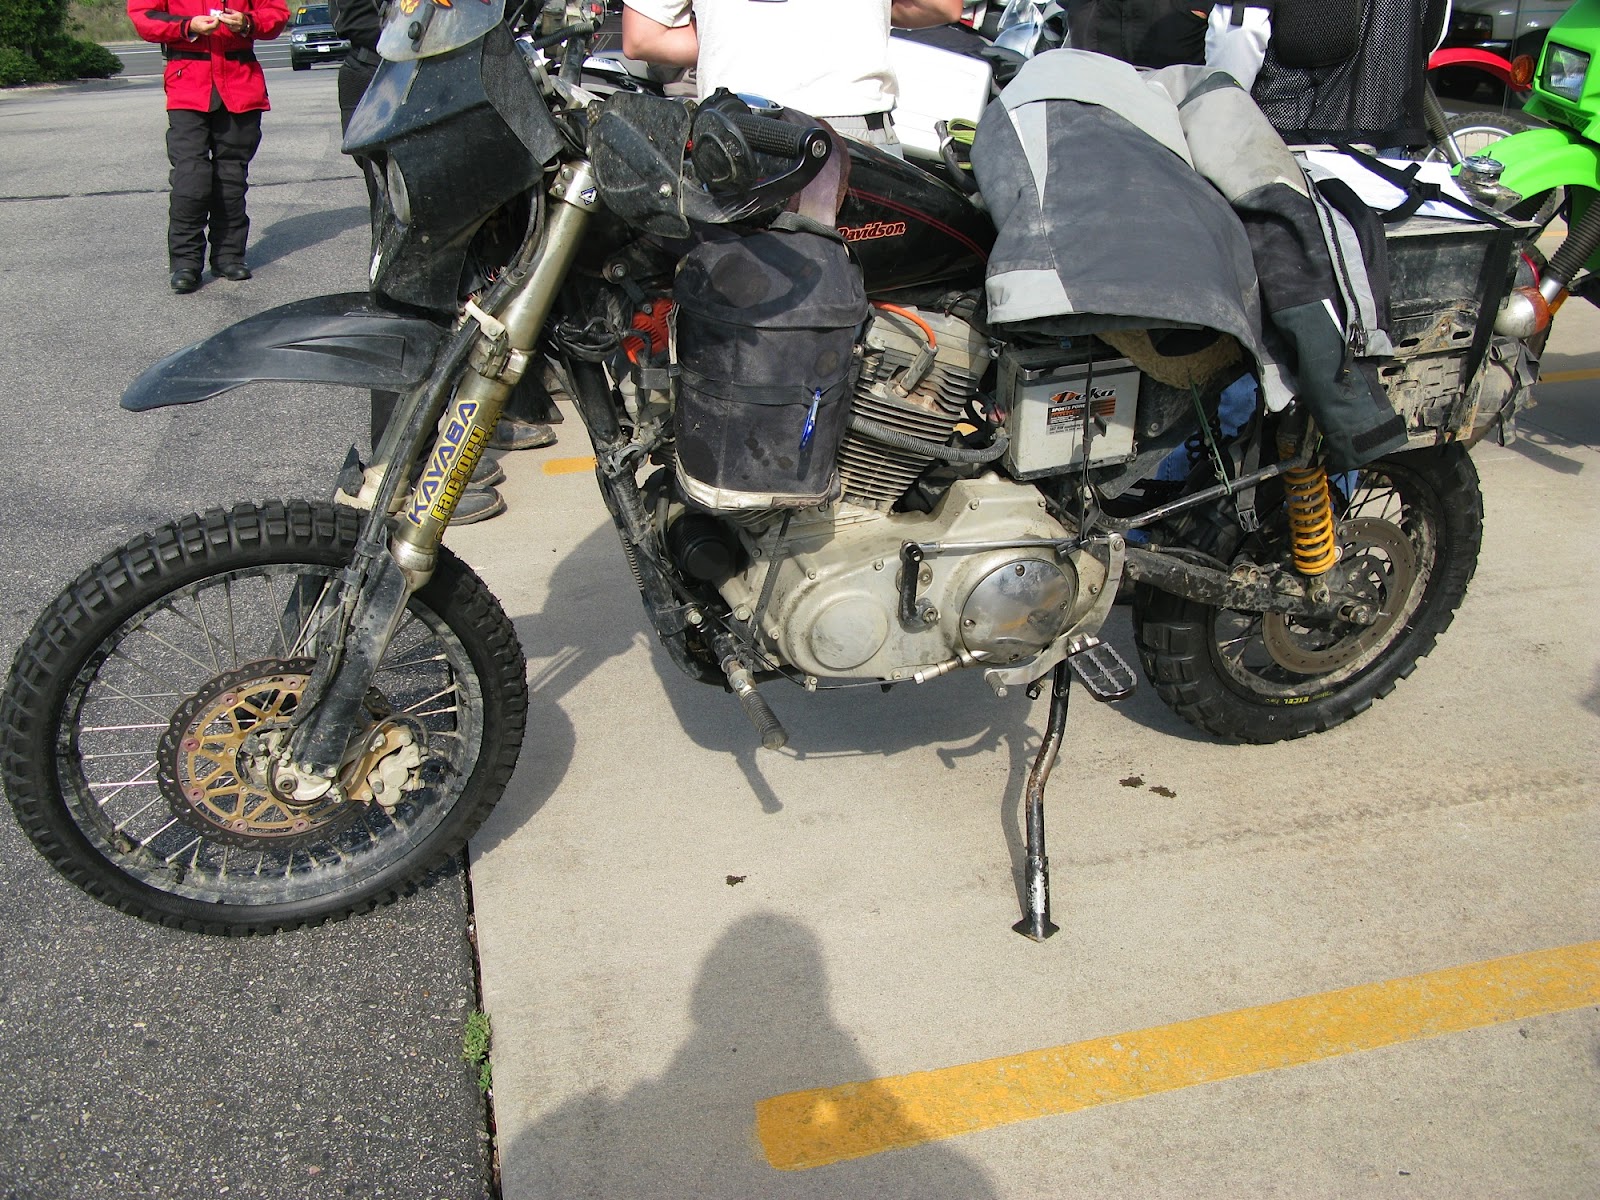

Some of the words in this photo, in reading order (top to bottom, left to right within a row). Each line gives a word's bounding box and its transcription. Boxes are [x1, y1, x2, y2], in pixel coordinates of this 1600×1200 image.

[838, 222, 905, 242] Davidson
[406, 400, 479, 527] KAYABA
[430, 425, 487, 521] Factory
[1283, 696, 1310, 705] EXCEL
